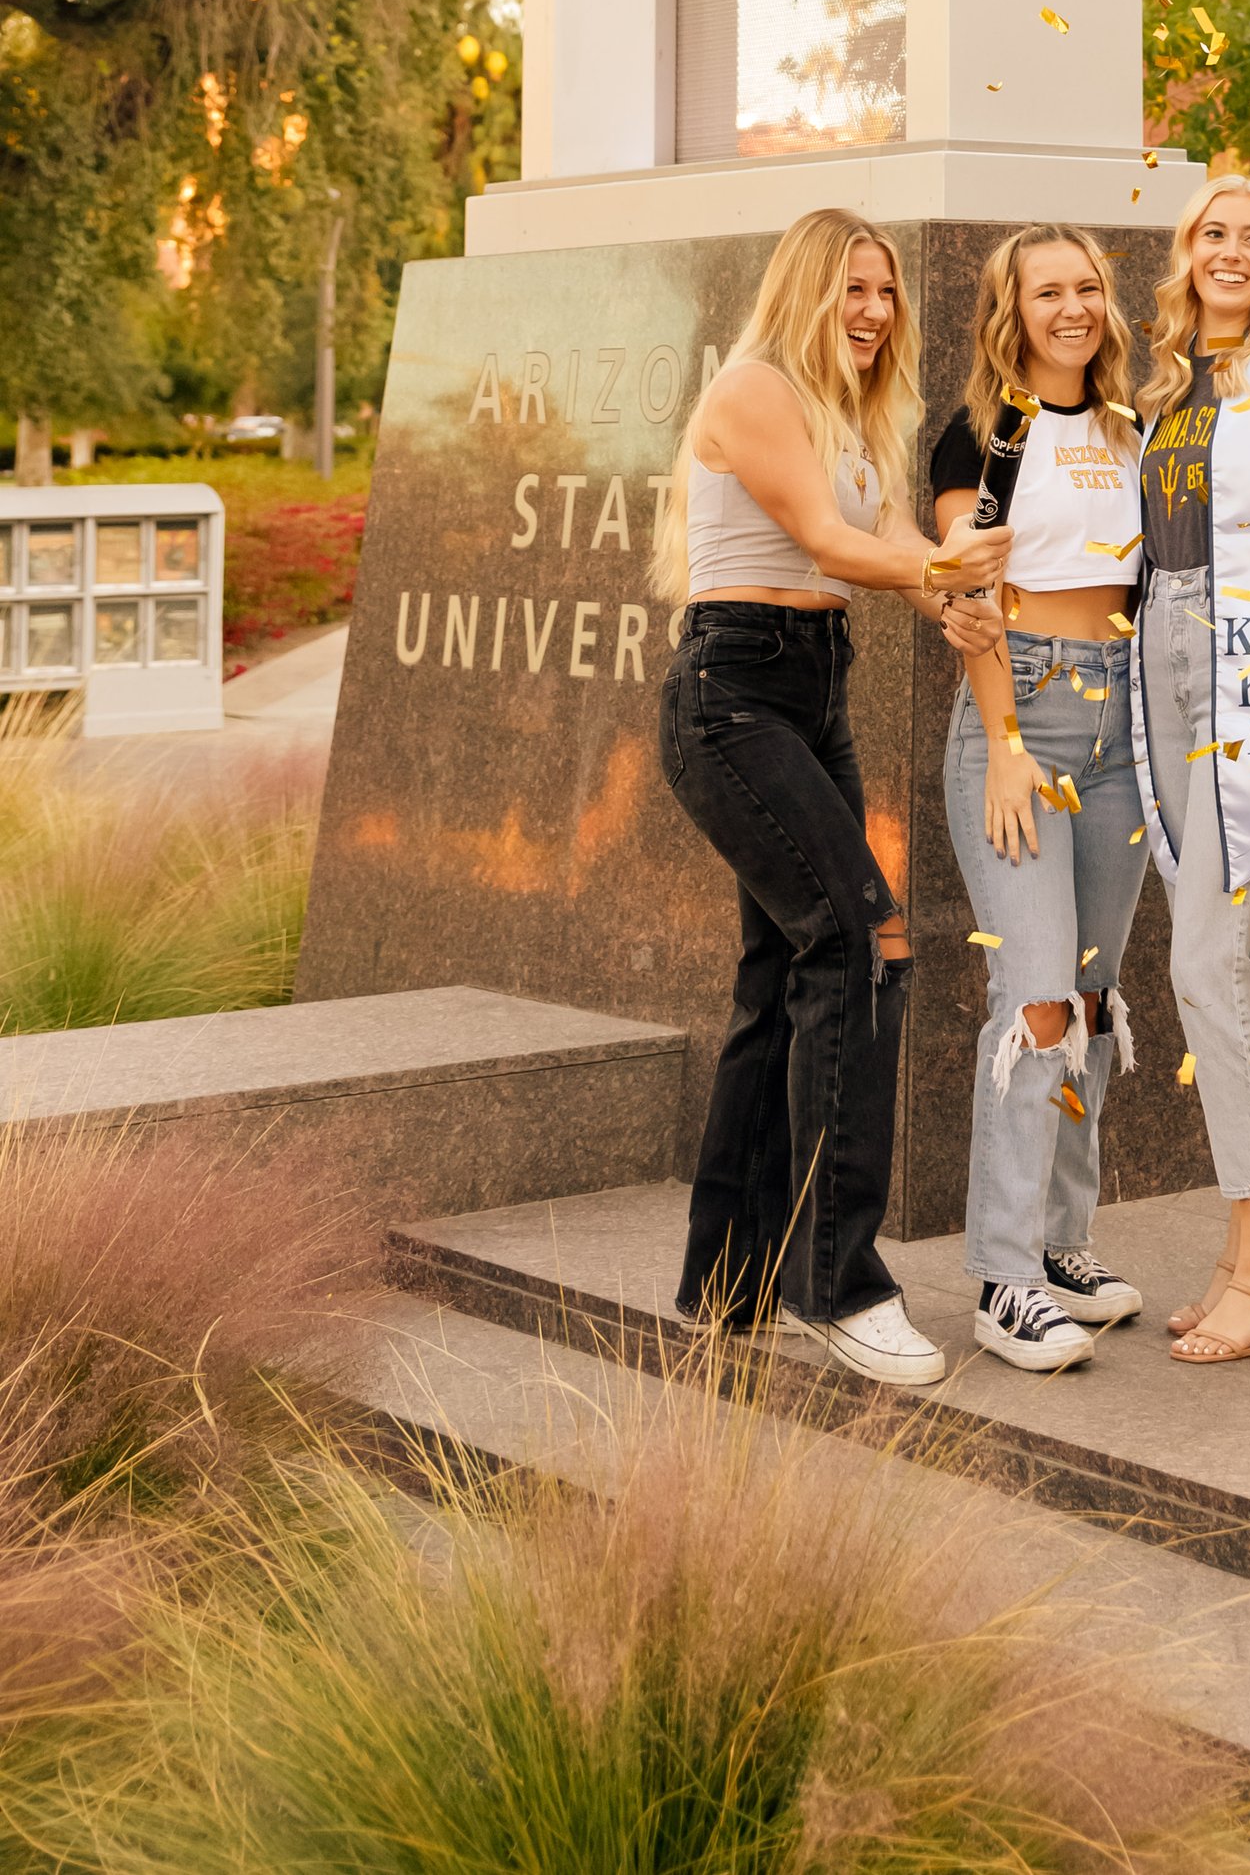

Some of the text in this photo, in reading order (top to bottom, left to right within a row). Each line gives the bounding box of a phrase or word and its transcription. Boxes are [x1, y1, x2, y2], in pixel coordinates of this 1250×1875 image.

[468, 344, 725, 425] ARIZO
[510, 472, 674, 553] STAT
[1069, 469, 1123, 489] STATE
[1187, 462, 1205, 491] 85
[396, 591, 684, 683] UNIVER
